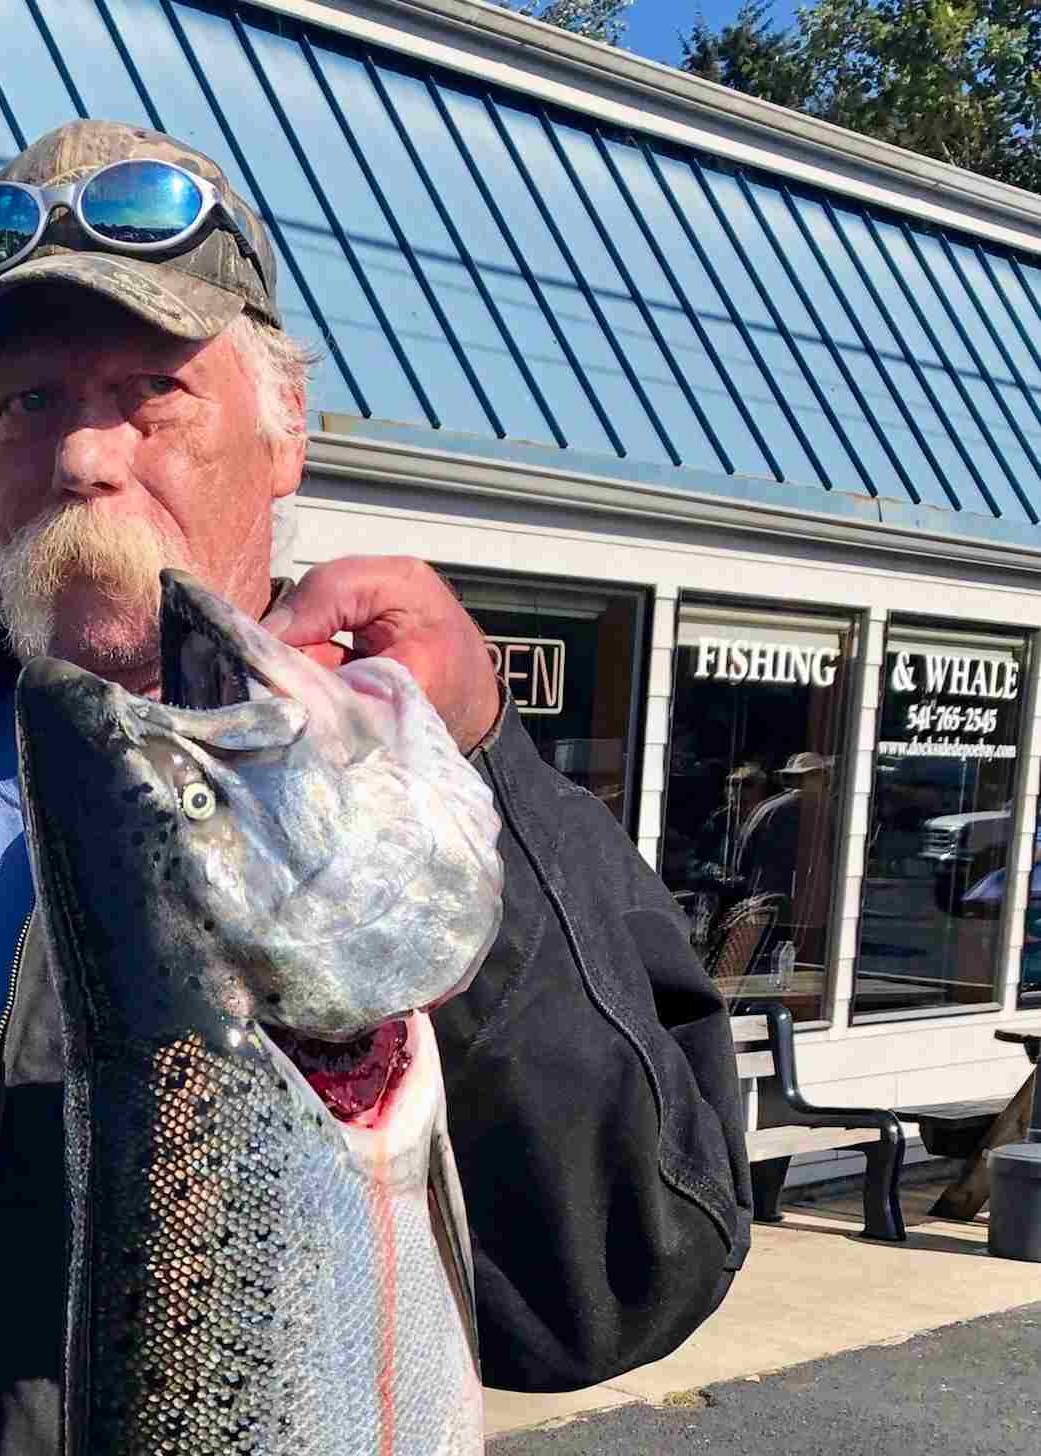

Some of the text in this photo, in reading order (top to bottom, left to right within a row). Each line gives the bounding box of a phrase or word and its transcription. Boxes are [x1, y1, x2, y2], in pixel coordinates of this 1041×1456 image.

[694, 637, 1020, 699] FISHING & WHALE
[906, 703, 998, 734] 541-765-2545
